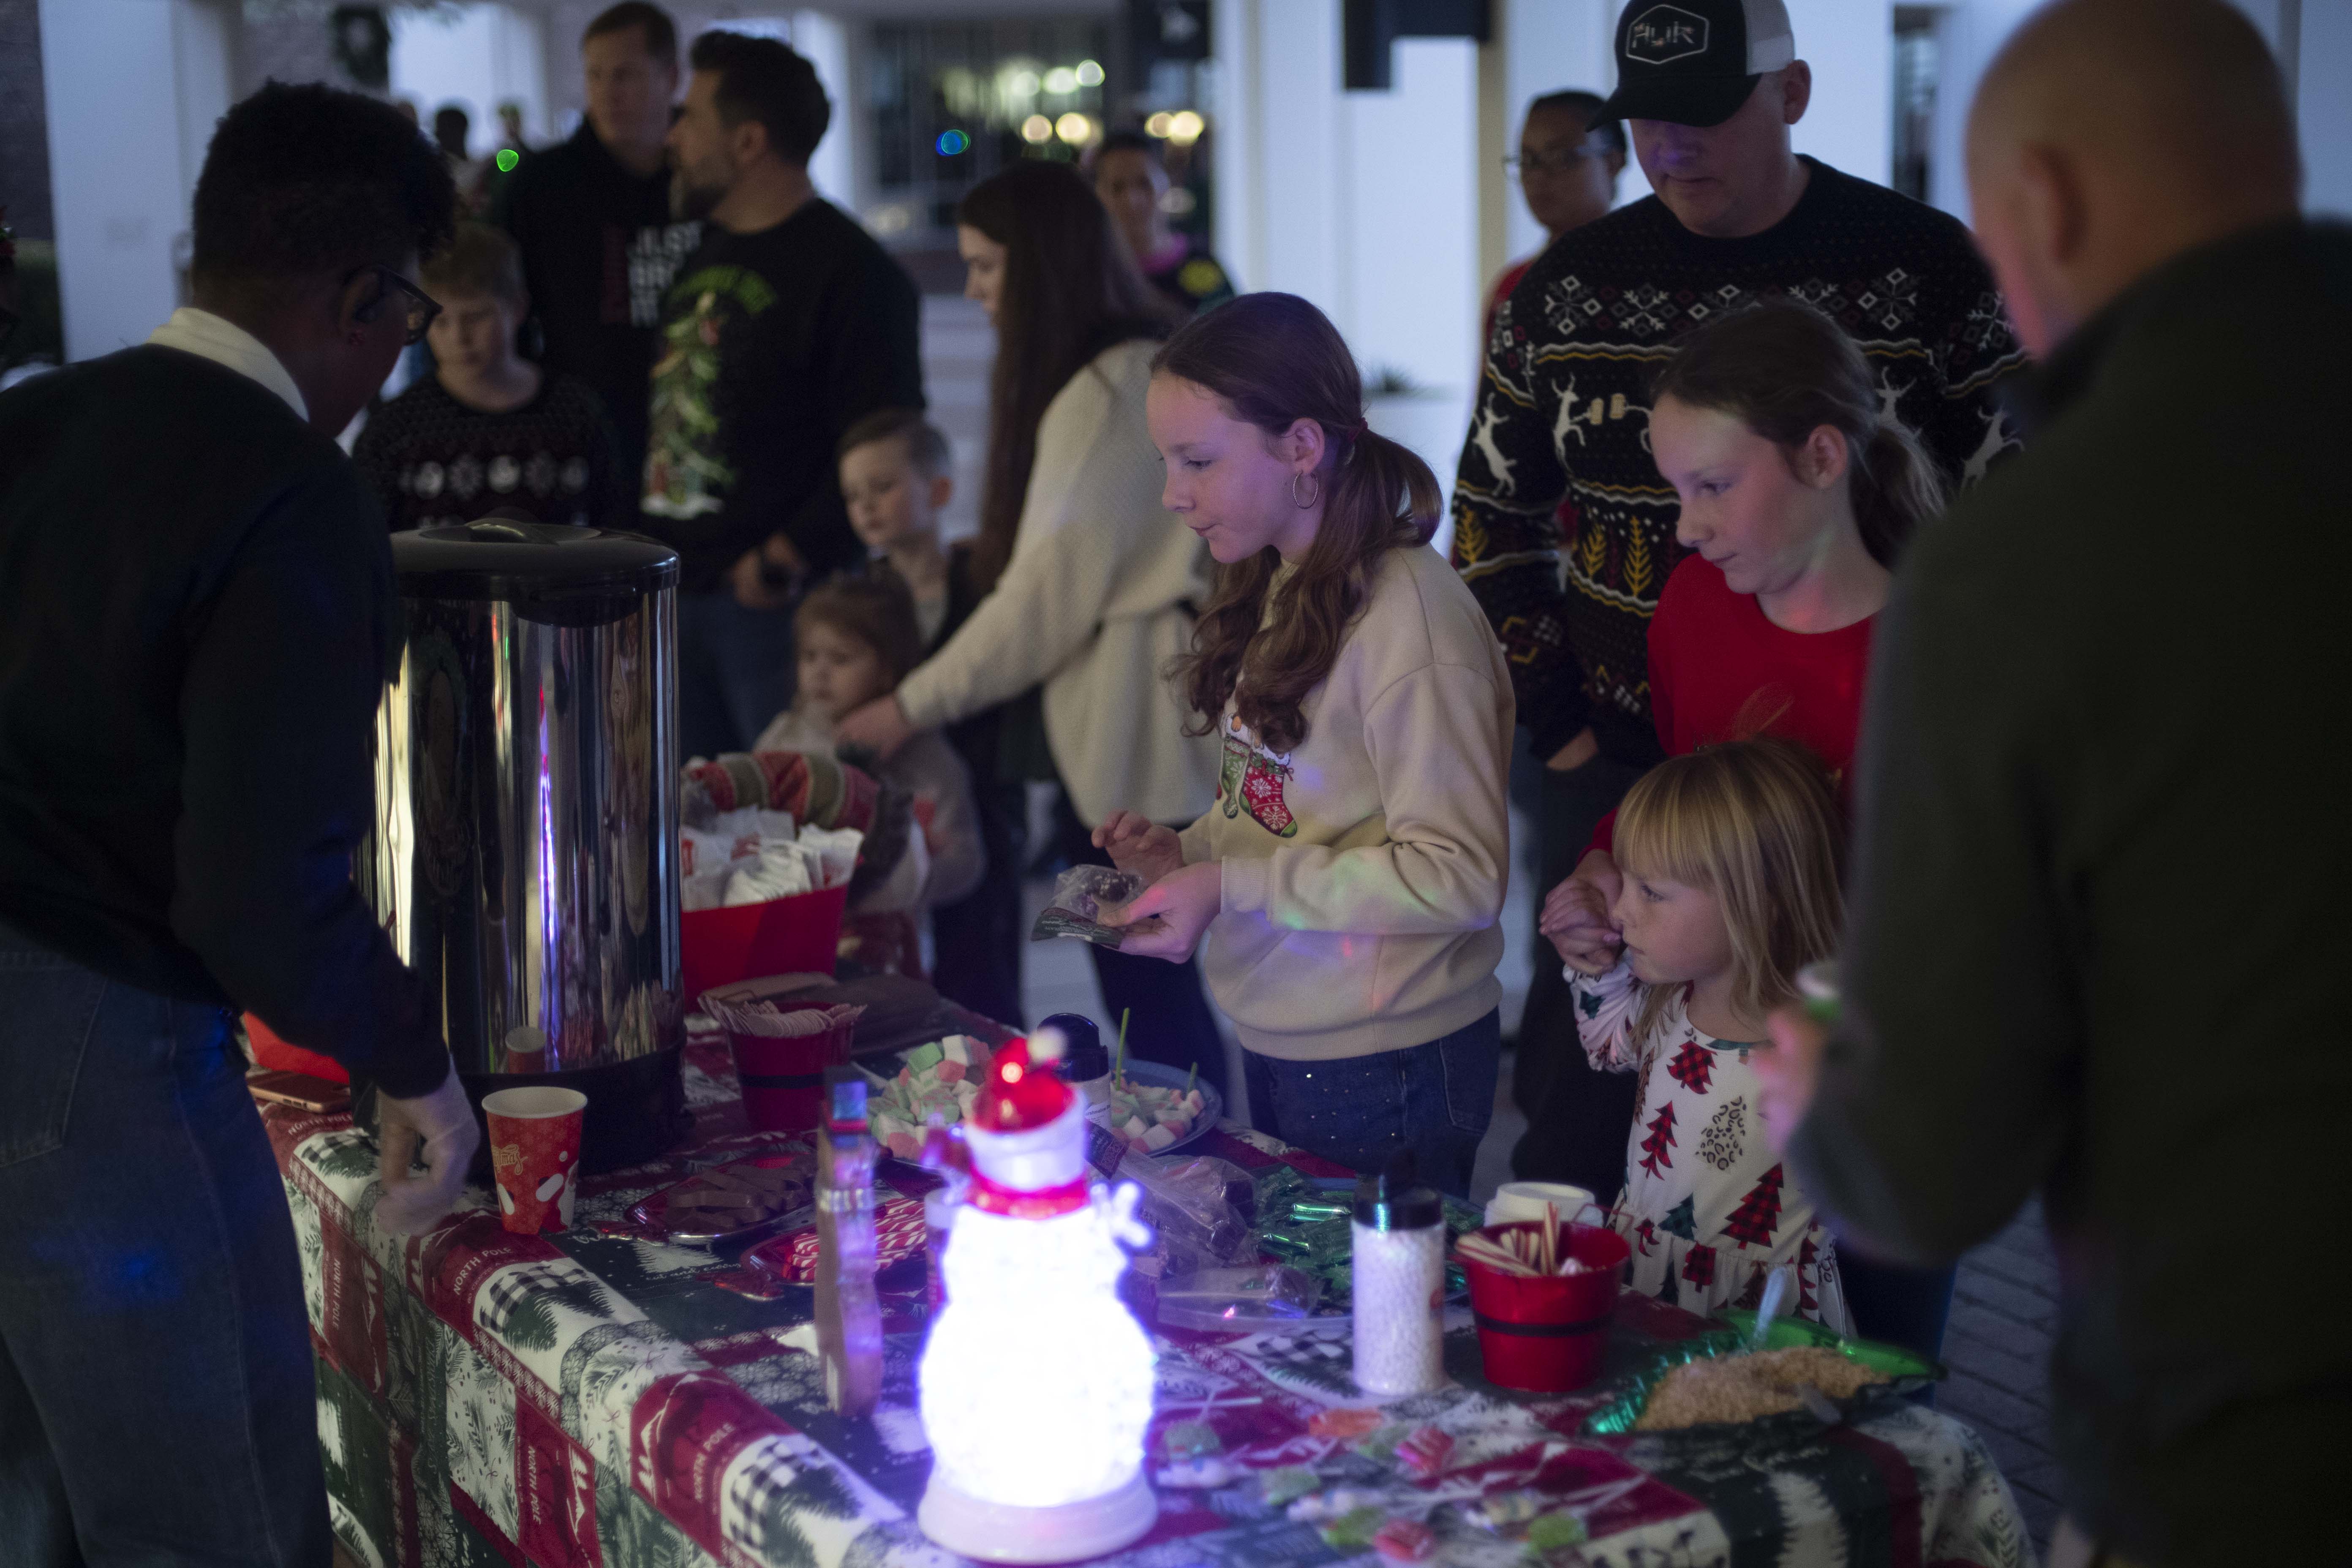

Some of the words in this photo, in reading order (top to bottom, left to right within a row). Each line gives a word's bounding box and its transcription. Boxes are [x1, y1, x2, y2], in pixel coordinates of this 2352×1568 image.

[288, 1117, 324, 1136] NORTH
[333, 1258, 341, 1298] NORTH
[453, 1257, 481, 1296] NORTH
[481, 1247, 514, 1258] POLE
[332, 1299, 340, 1331] POLE
[528, 1445, 537, 1490] NORTH
[693, 1453, 707, 1503] NORTH
[703, 1423, 736, 1452] POLE
[530, 1492, 542, 1525] POLE
